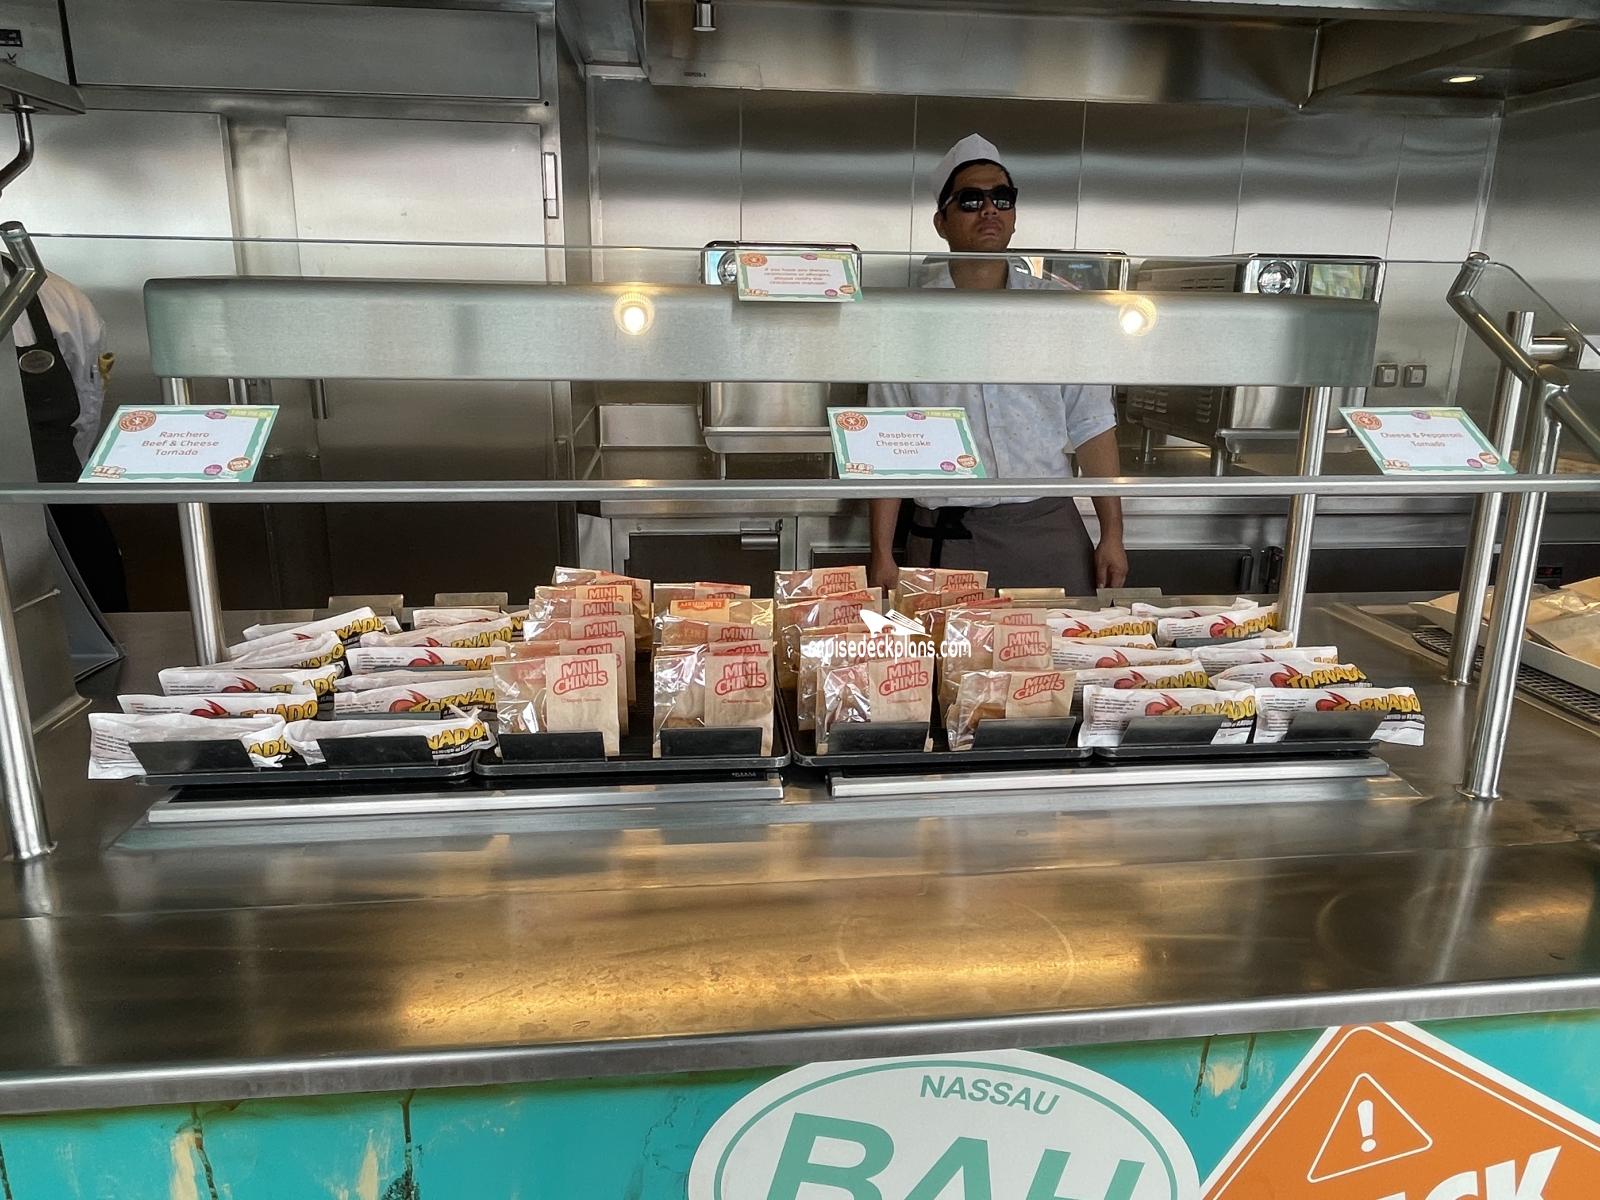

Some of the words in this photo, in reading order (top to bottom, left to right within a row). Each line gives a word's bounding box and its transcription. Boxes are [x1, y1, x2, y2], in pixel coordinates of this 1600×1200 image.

[878, 432, 925, 440] Raspberry
[823, 573, 850, 584] MINI
[947, 573, 974, 585] MINI
[588, 587, 617, 600] MINI
[584, 602, 614, 615] MINI
[1003, 613, 1033, 625] MINI
[585, 620, 617, 637] MINI
[721, 627, 753, 640] MINI
[1008, 631, 1039, 647] MINI
[999, 641, 1049, 661] CHIMIS
[561, 659, 598, 679] MINI
[723, 661, 758, 680] MINI
[887, 660, 921, 679] MINI
[553, 670, 608, 695] CHIMIS
[715, 673, 767, 696] CHIMIS
[879, 671, 929, 696] CHIMIS
[1013, 679, 1065, 700] CHIMIS
[1024, 673, 1060, 689] MINI
[920, 1075, 1060, 1116] NASSAU
